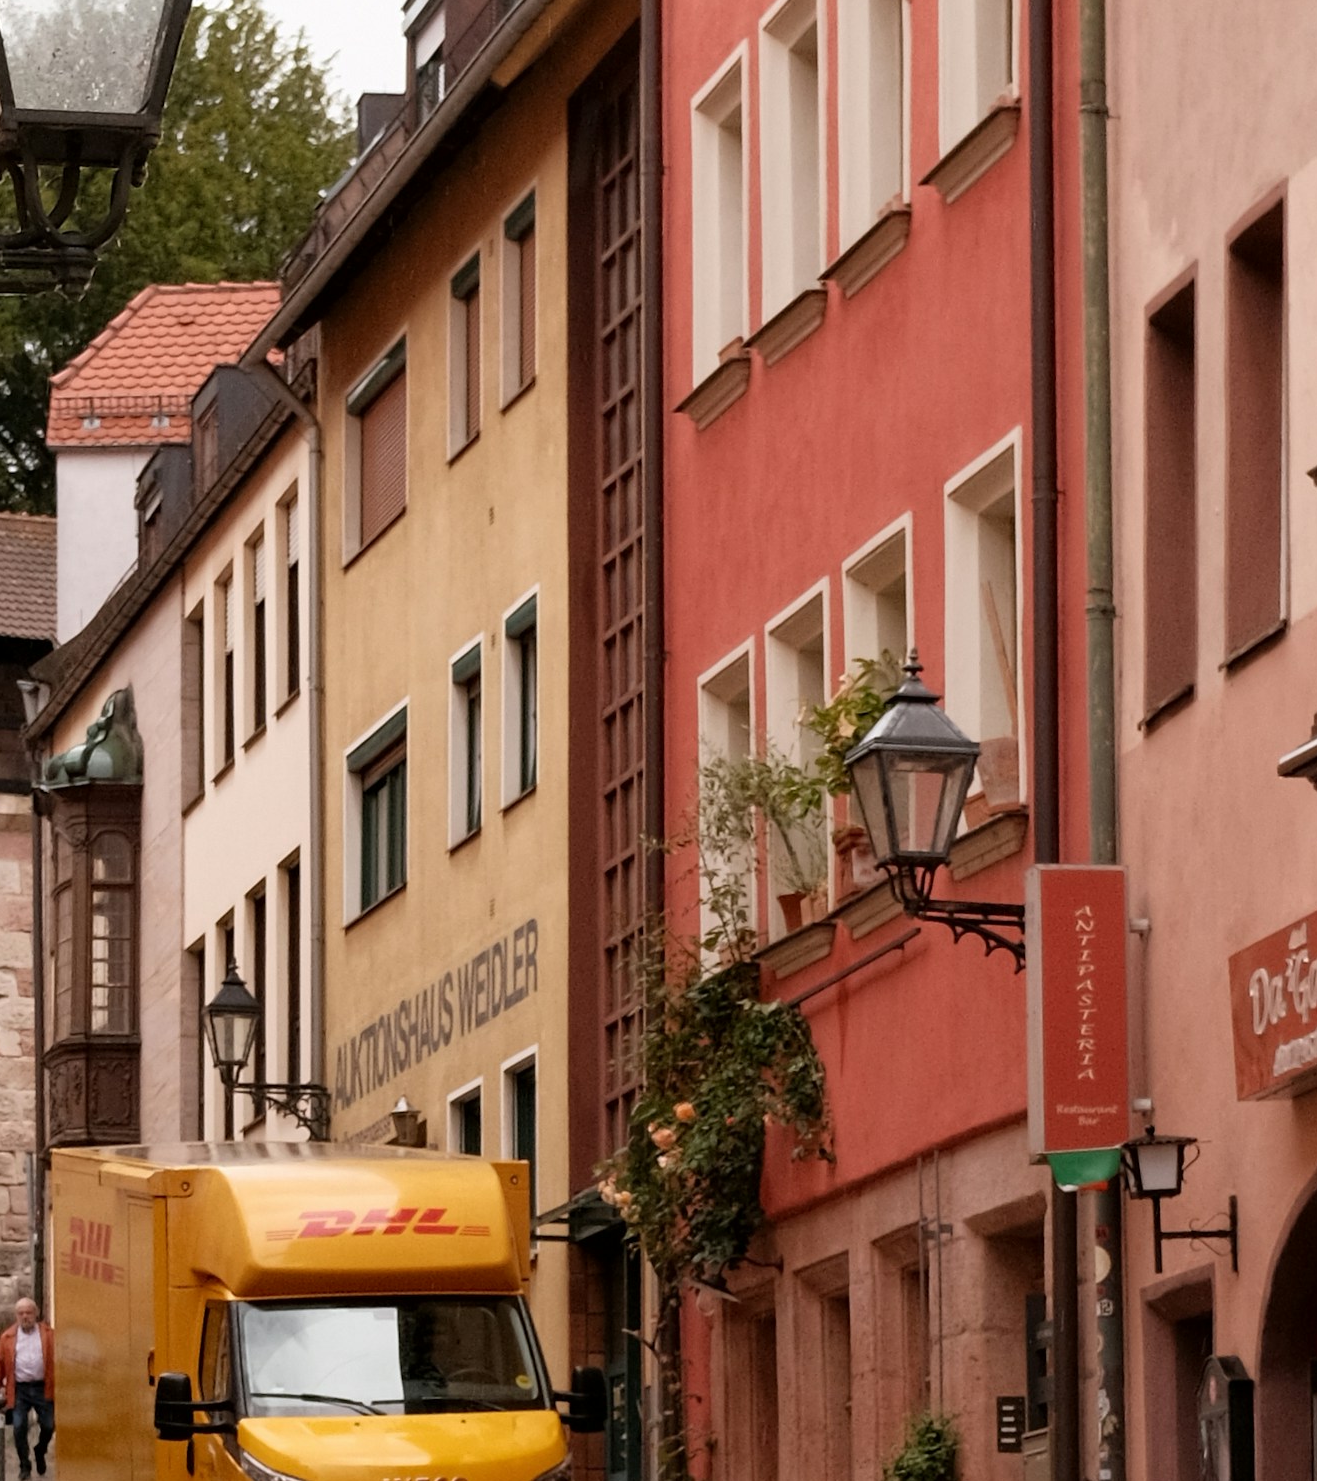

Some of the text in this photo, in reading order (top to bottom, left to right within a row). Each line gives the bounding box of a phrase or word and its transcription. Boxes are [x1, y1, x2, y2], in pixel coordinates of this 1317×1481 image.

[334, 918, 538, 1114] AUKTIONSHAUS WEIDLER
[1075, 905, 1097, 1080] ANTIPASTERIA
[1248, 967, 1287, 1035] Da
[1055, 1103, 1118, 1115] Restaurant
[1077, 1115, 1099, 1126] Bar
[69, 1217, 116, 1285] DHL
[296, 1208, 460, 1239] DHL
